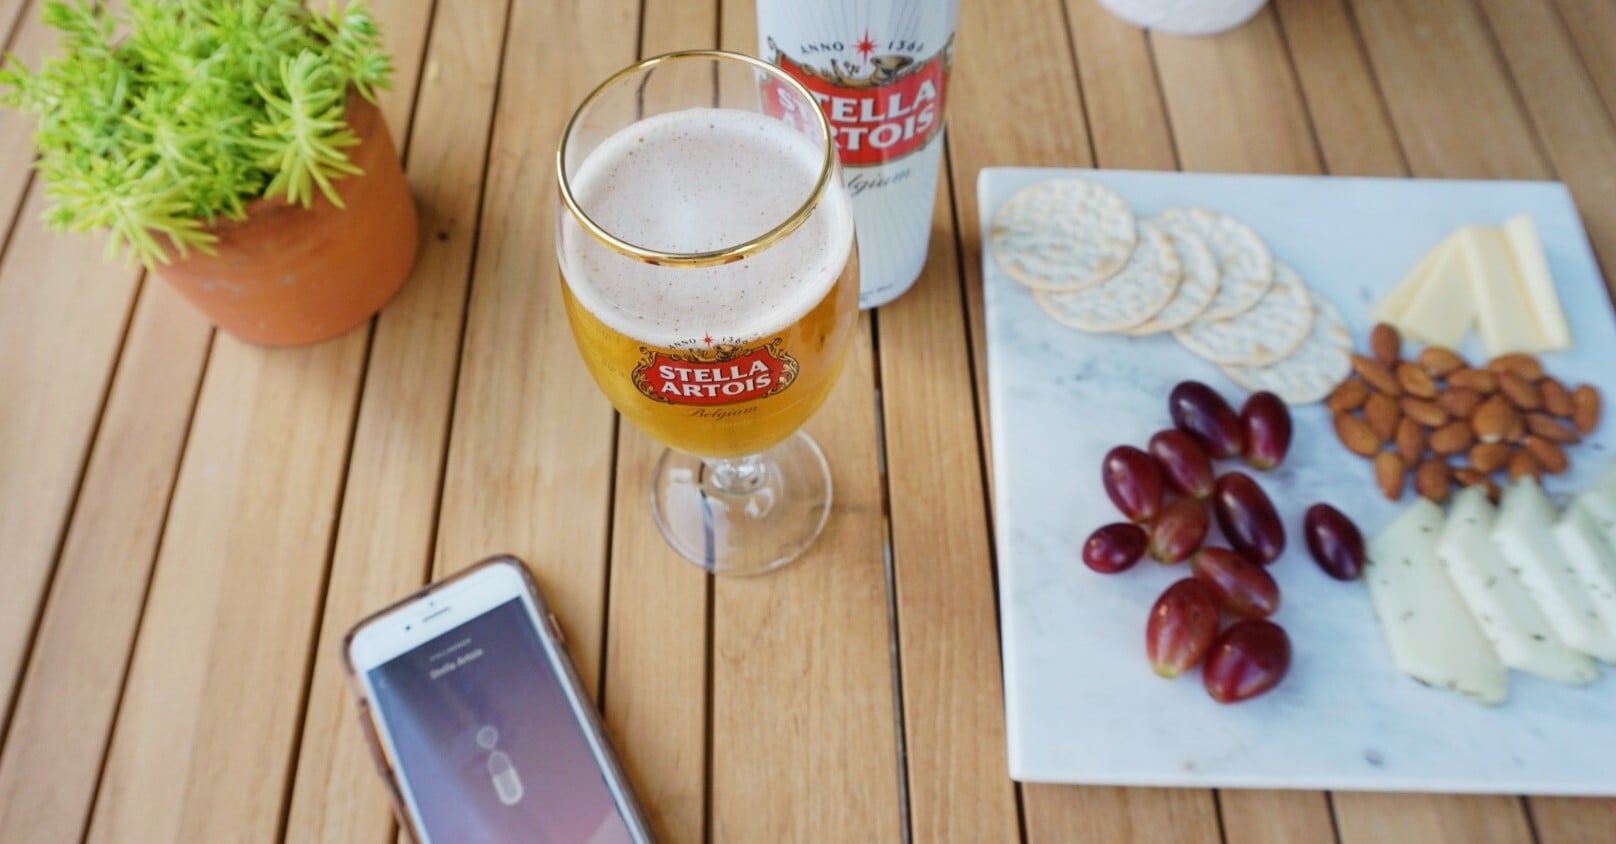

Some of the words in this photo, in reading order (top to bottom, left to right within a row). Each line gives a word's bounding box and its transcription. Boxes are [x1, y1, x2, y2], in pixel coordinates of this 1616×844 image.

[801, 41, 844, 54] ANNO
[777, 79, 937, 123] STELLA
[847, 168, 912, 197] lgium
[669, 338, 697, 350] ANNO
[659, 360, 769, 383] STELLA
[661, 374, 772, 398] ARTOIS
[688, 406, 758, 420] Belgium
